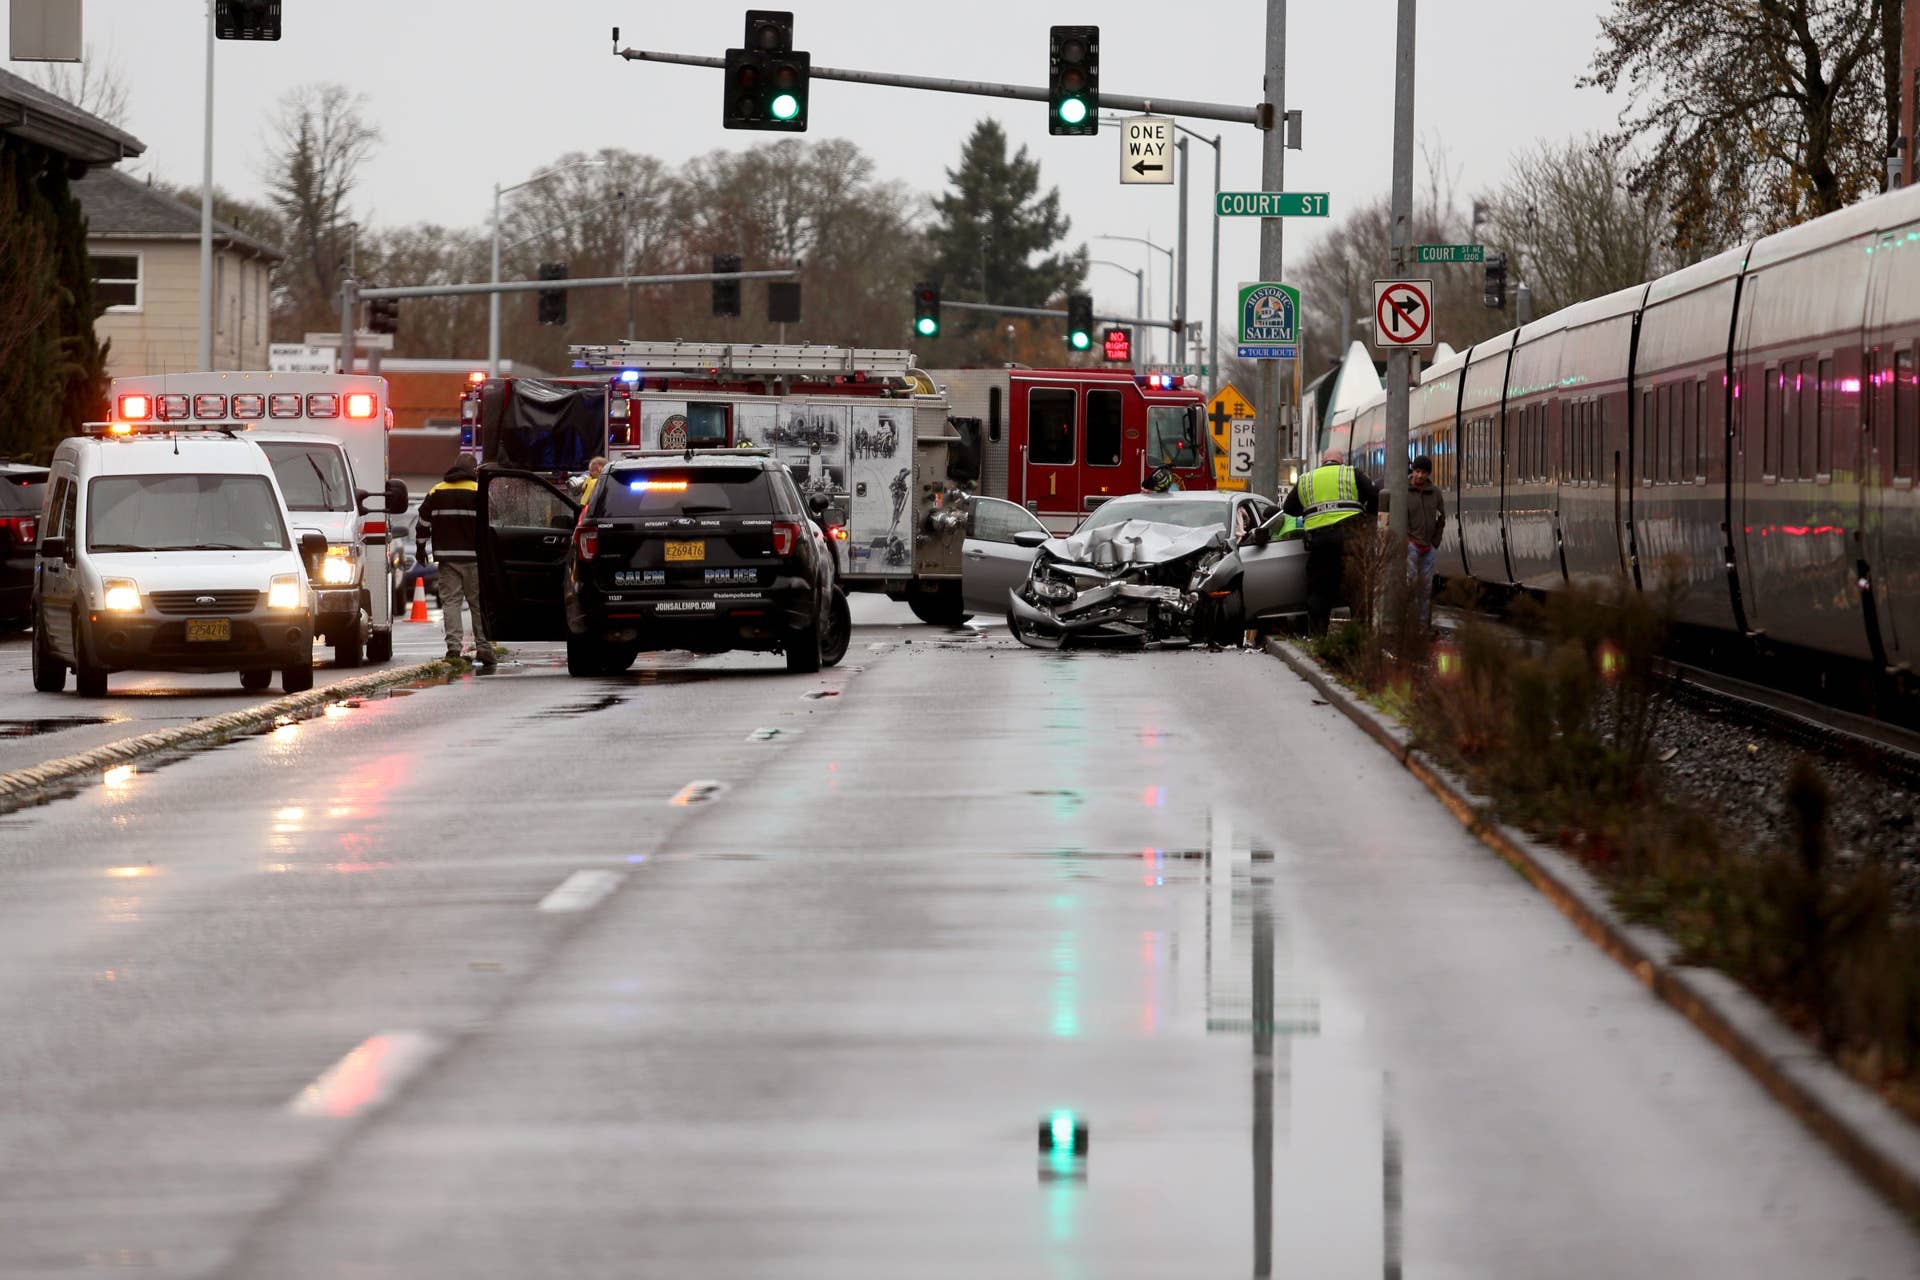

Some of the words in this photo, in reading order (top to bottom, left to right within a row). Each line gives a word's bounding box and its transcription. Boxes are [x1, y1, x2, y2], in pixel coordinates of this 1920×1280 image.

[1130, 125, 1165, 139] ONE
[1129, 142, 1166, 156] WAY
[1221, 195, 1281, 214] COURT
[1301, 195, 1324, 214] ST
[1423, 247, 1456, 260] COURT
[1463, 253, 1479, 261] 1200
[1248, 288, 1292, 306] HISTORIC
[1110, 331, 1125, 341] NO
[1246, 327, 1291, 340] SALEM
[1105, 341, 1129, 350] RIGHT
[1106, 350, 1128, 359] TURN
[1247, 348, 1269, 356] TOUR
[1234, 424, 1256, 434] SPE
[1238, 438, 1256, 447] LIM
[1235, 452, 1256, 473] 3
[1048, 471, 1057, 496] 1
[1317, 502, 1339, 512] POLICE
[666, 545, 703, 557] E269476
[614, 570, 666, 586] SALEM
[704, 568, 758, 584] POLICE
